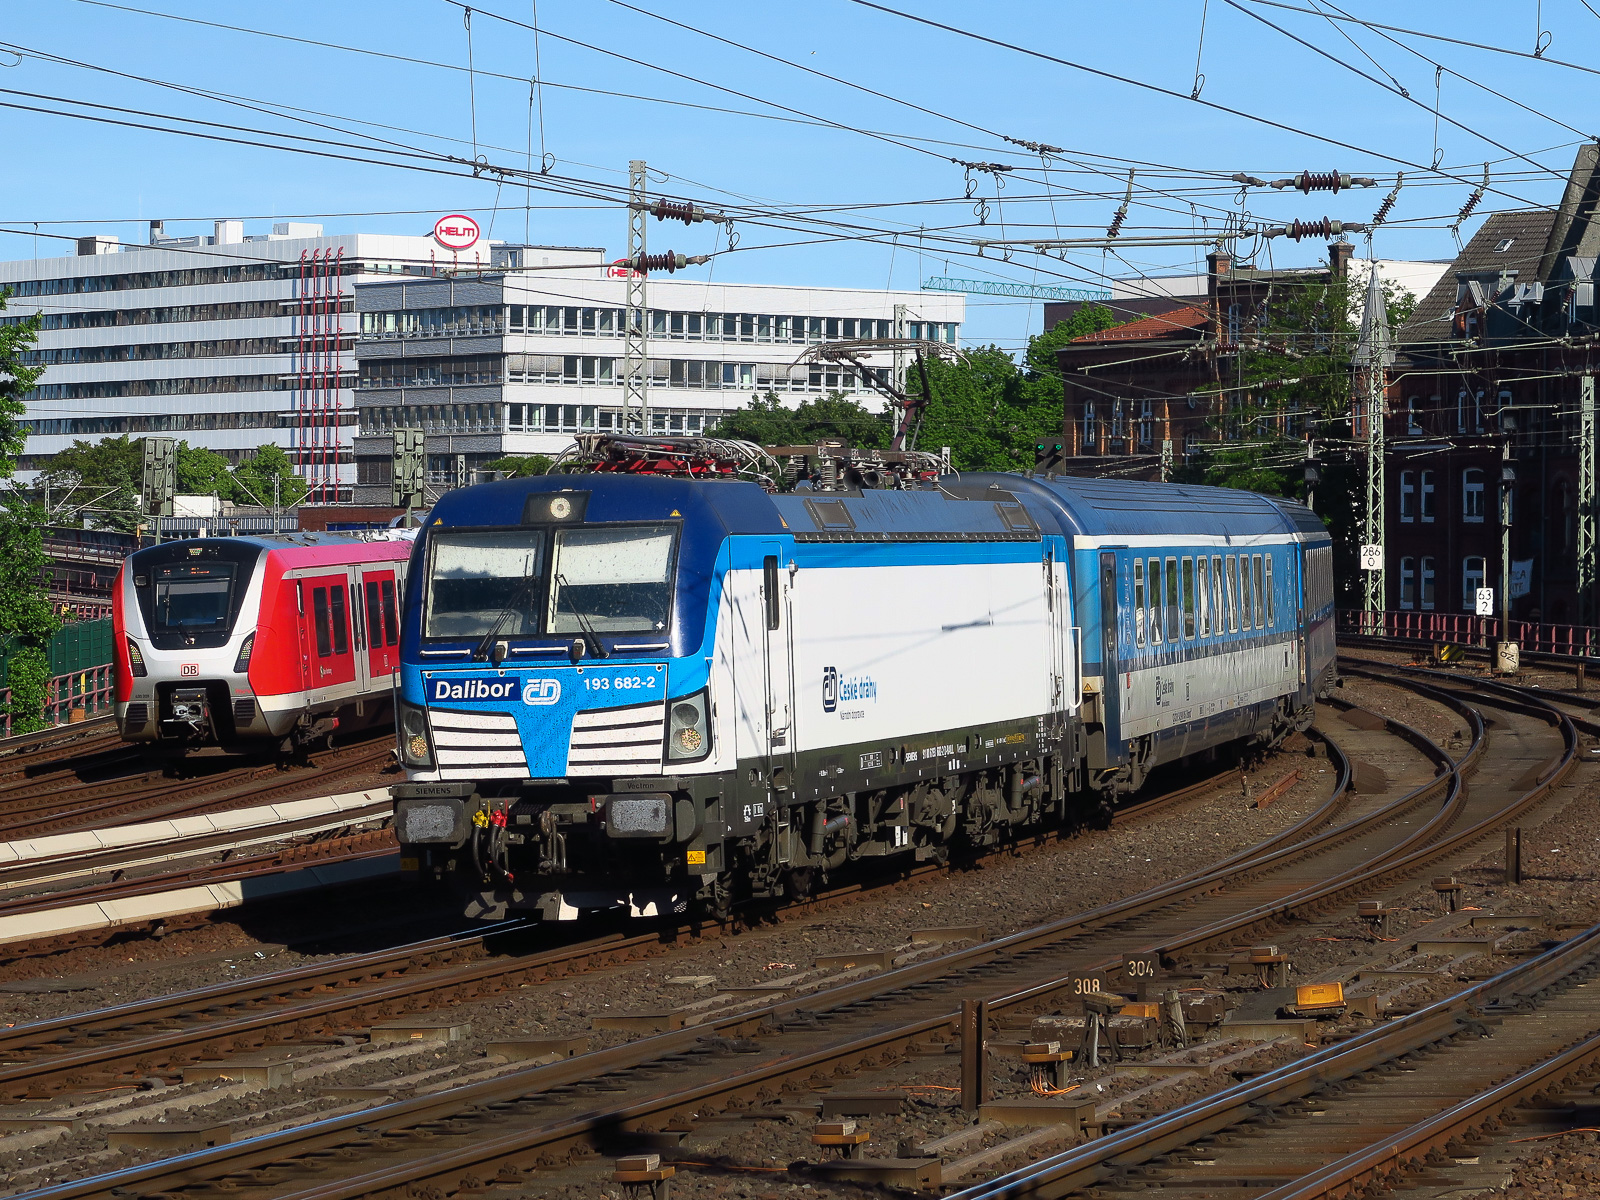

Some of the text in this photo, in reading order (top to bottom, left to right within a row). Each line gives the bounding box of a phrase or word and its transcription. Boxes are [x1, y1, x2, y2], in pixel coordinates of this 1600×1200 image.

[439, 226, 475, 237] HELM
[1362, 546, 1381, 557] 286
[1367, 557, 1375, 567] 0
[1478, 590, 1492, 601] 63
[1481, 601, 1488, 612] 2
[183, 665, 197, 675] DB
[583, 676, 656, 690] 193 682-2
[839, 673, 877, 704] České dráhy
[435, 679, 514, 700] Dalibor
[415, 787, 452, 795] SIEMENS
[626, 782, 655, 790] Vectron
[1128, 960, 1154, 977] 304
[1074, 978, 1100, 995] 308
